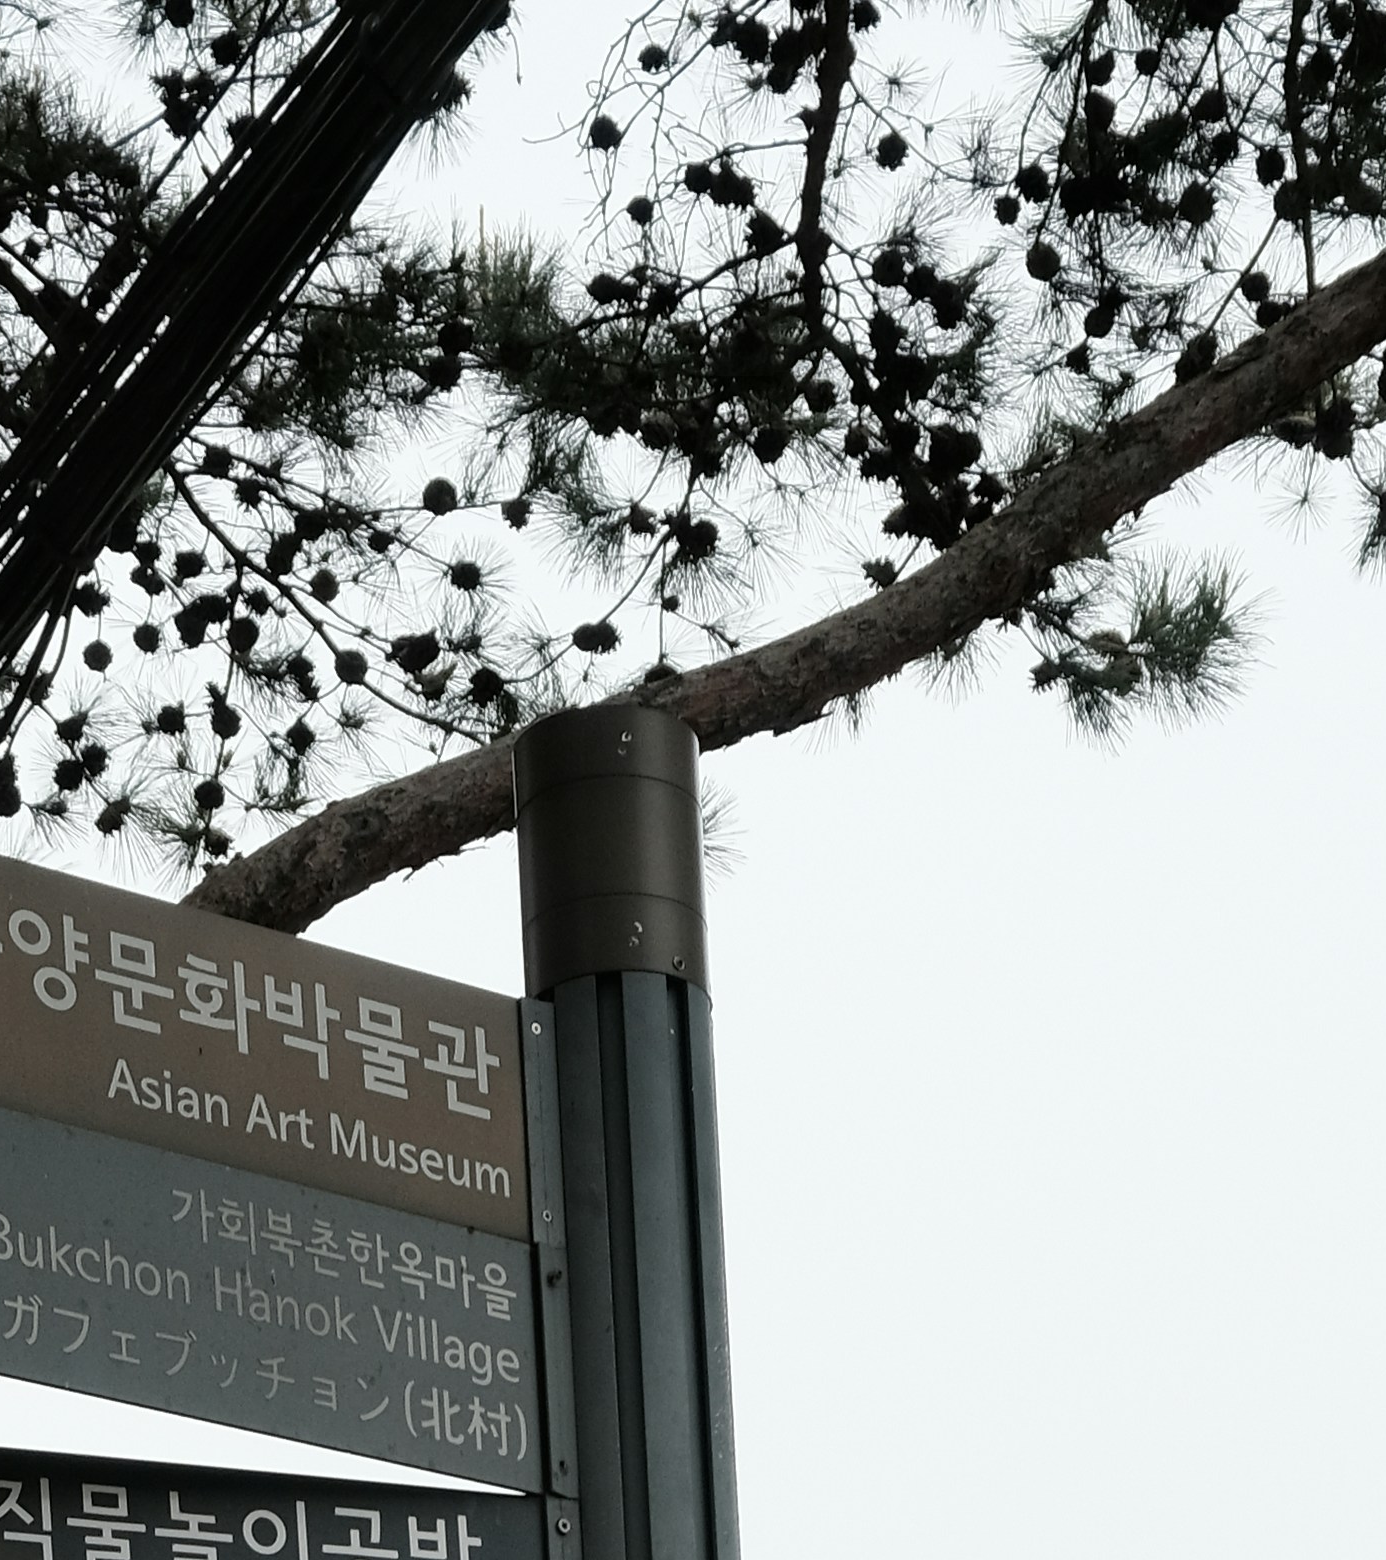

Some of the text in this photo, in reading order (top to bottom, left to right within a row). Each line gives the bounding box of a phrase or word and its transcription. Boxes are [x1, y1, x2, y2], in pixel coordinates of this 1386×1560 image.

[108, 1059, 510, 1197] Asian Art Museum
[173, 1190, 516, 1320] 가회북촌한옥마을
[215, 1267, 357, 1343] Hanok
[373, 1305, 519, 1385] Village
